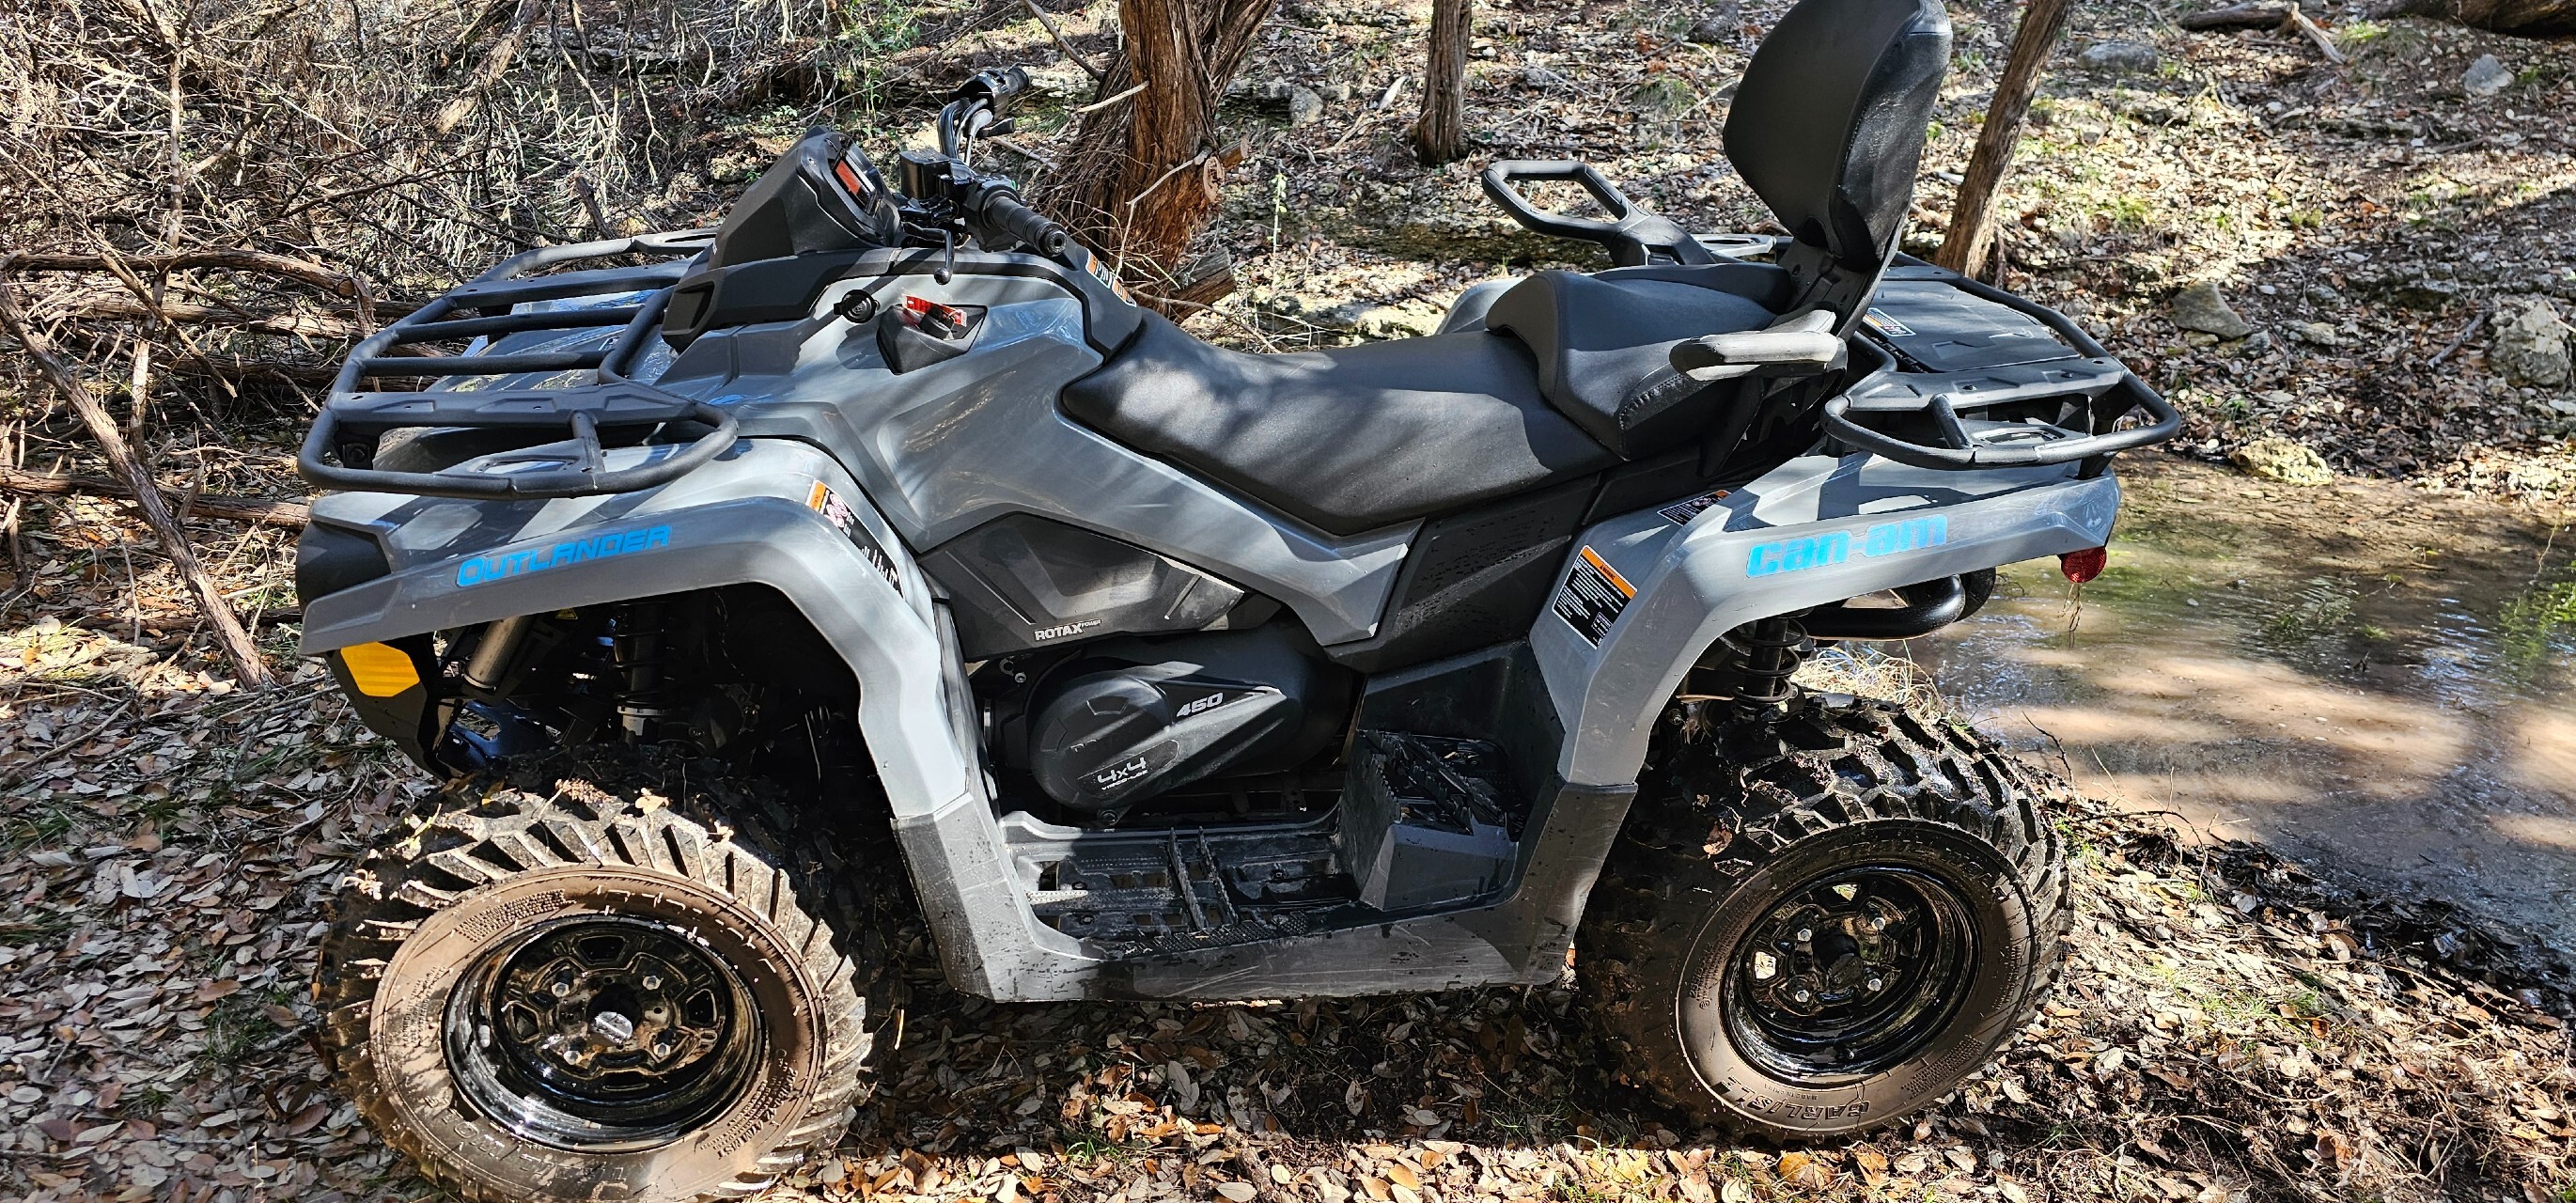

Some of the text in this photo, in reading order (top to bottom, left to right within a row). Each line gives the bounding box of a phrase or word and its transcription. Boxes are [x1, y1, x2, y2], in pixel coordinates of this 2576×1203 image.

[457, 525, 672, 587] OUTLANDER
[1746, 514, 1948, 578] can-am
[1035, 622, 1084, 641] ROTAX
[1177, 692, 1224, 718] 450
[1097, 757, 1147, 783] 4x4
